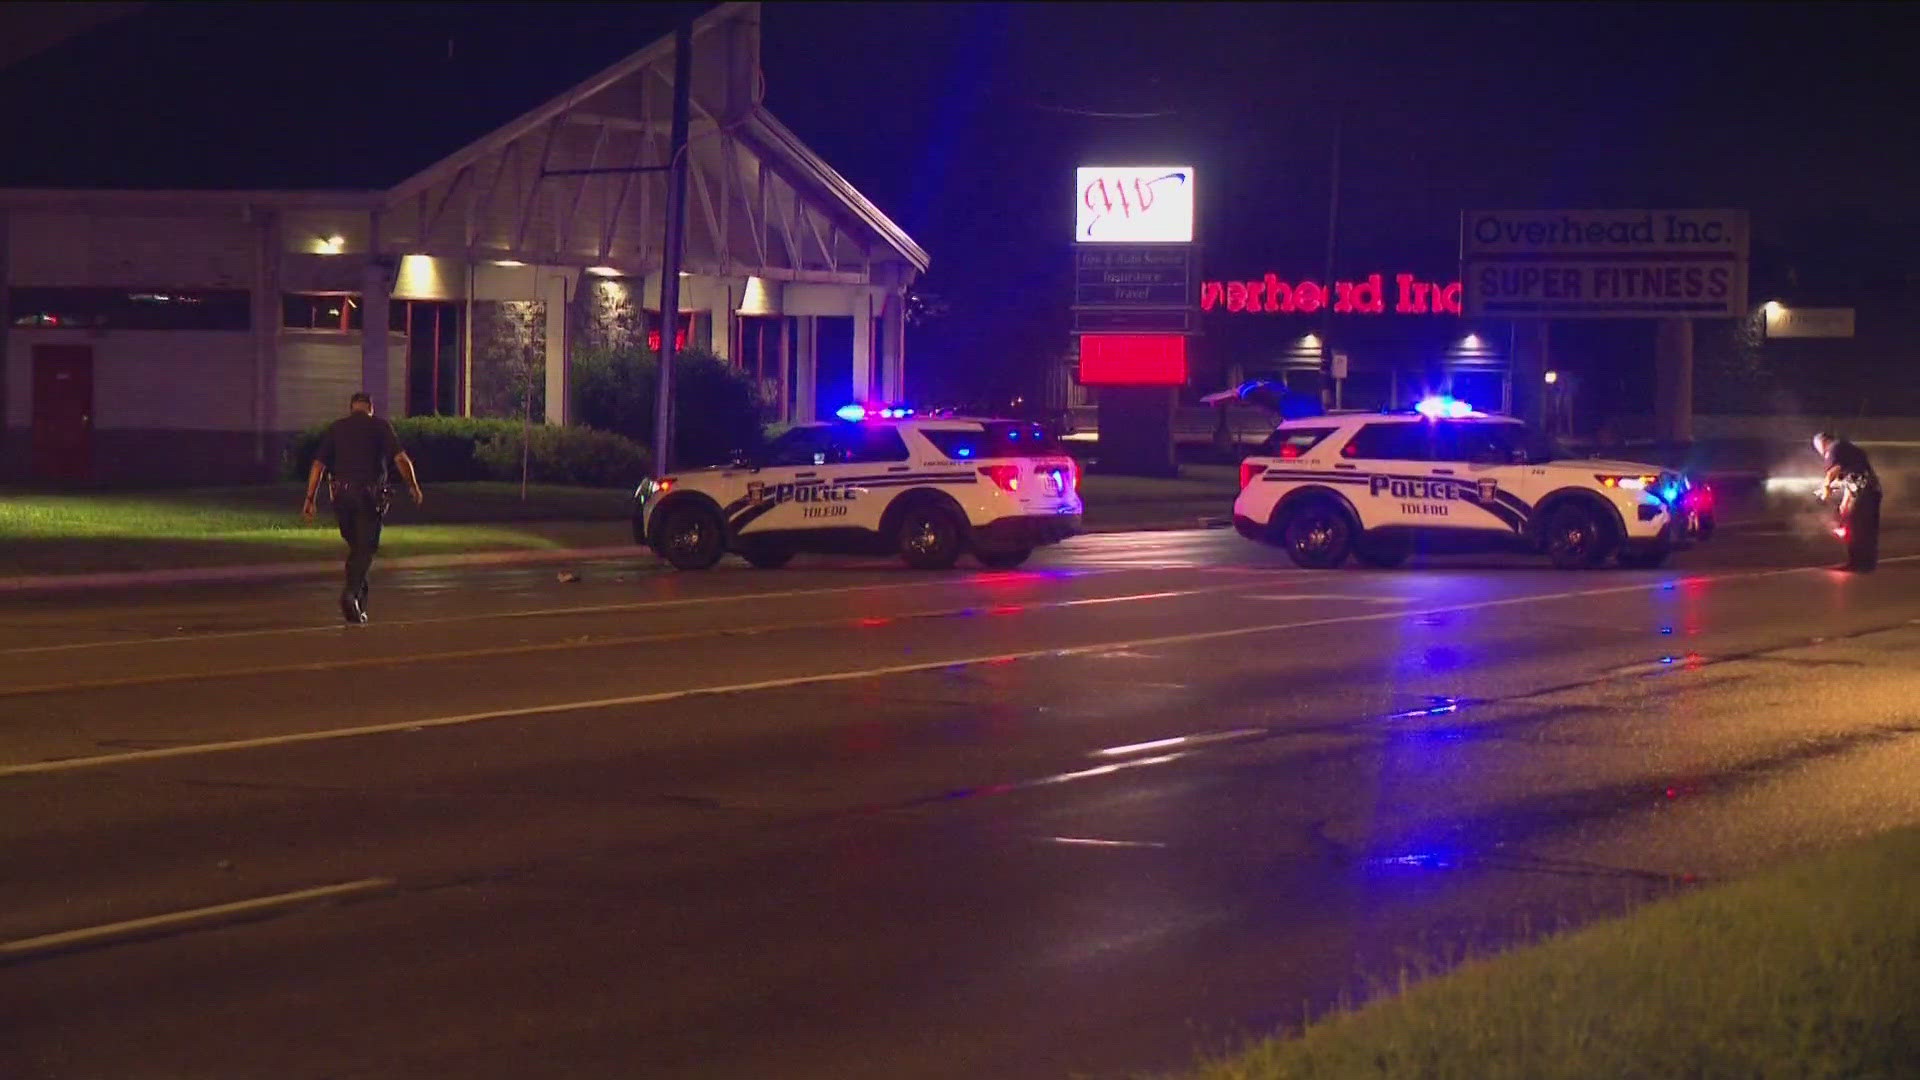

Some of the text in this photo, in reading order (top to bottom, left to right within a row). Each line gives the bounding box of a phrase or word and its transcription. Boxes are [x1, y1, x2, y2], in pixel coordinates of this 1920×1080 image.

[1475, 215, 1732, 245] Overhead Inc.
[1103, 271, 1163, 283] Insurance
[1480, 266, 1730, 299] SUPER FITNESS
[1115, 286, 1150, 299] Travel
[774, 483, 858, 503] POLICE
[1369, 474, 1460, 500] POLICE
[801, 505, 848, 518] TOLEDO
[1399, 502, 1449, 516] TOLEDO
